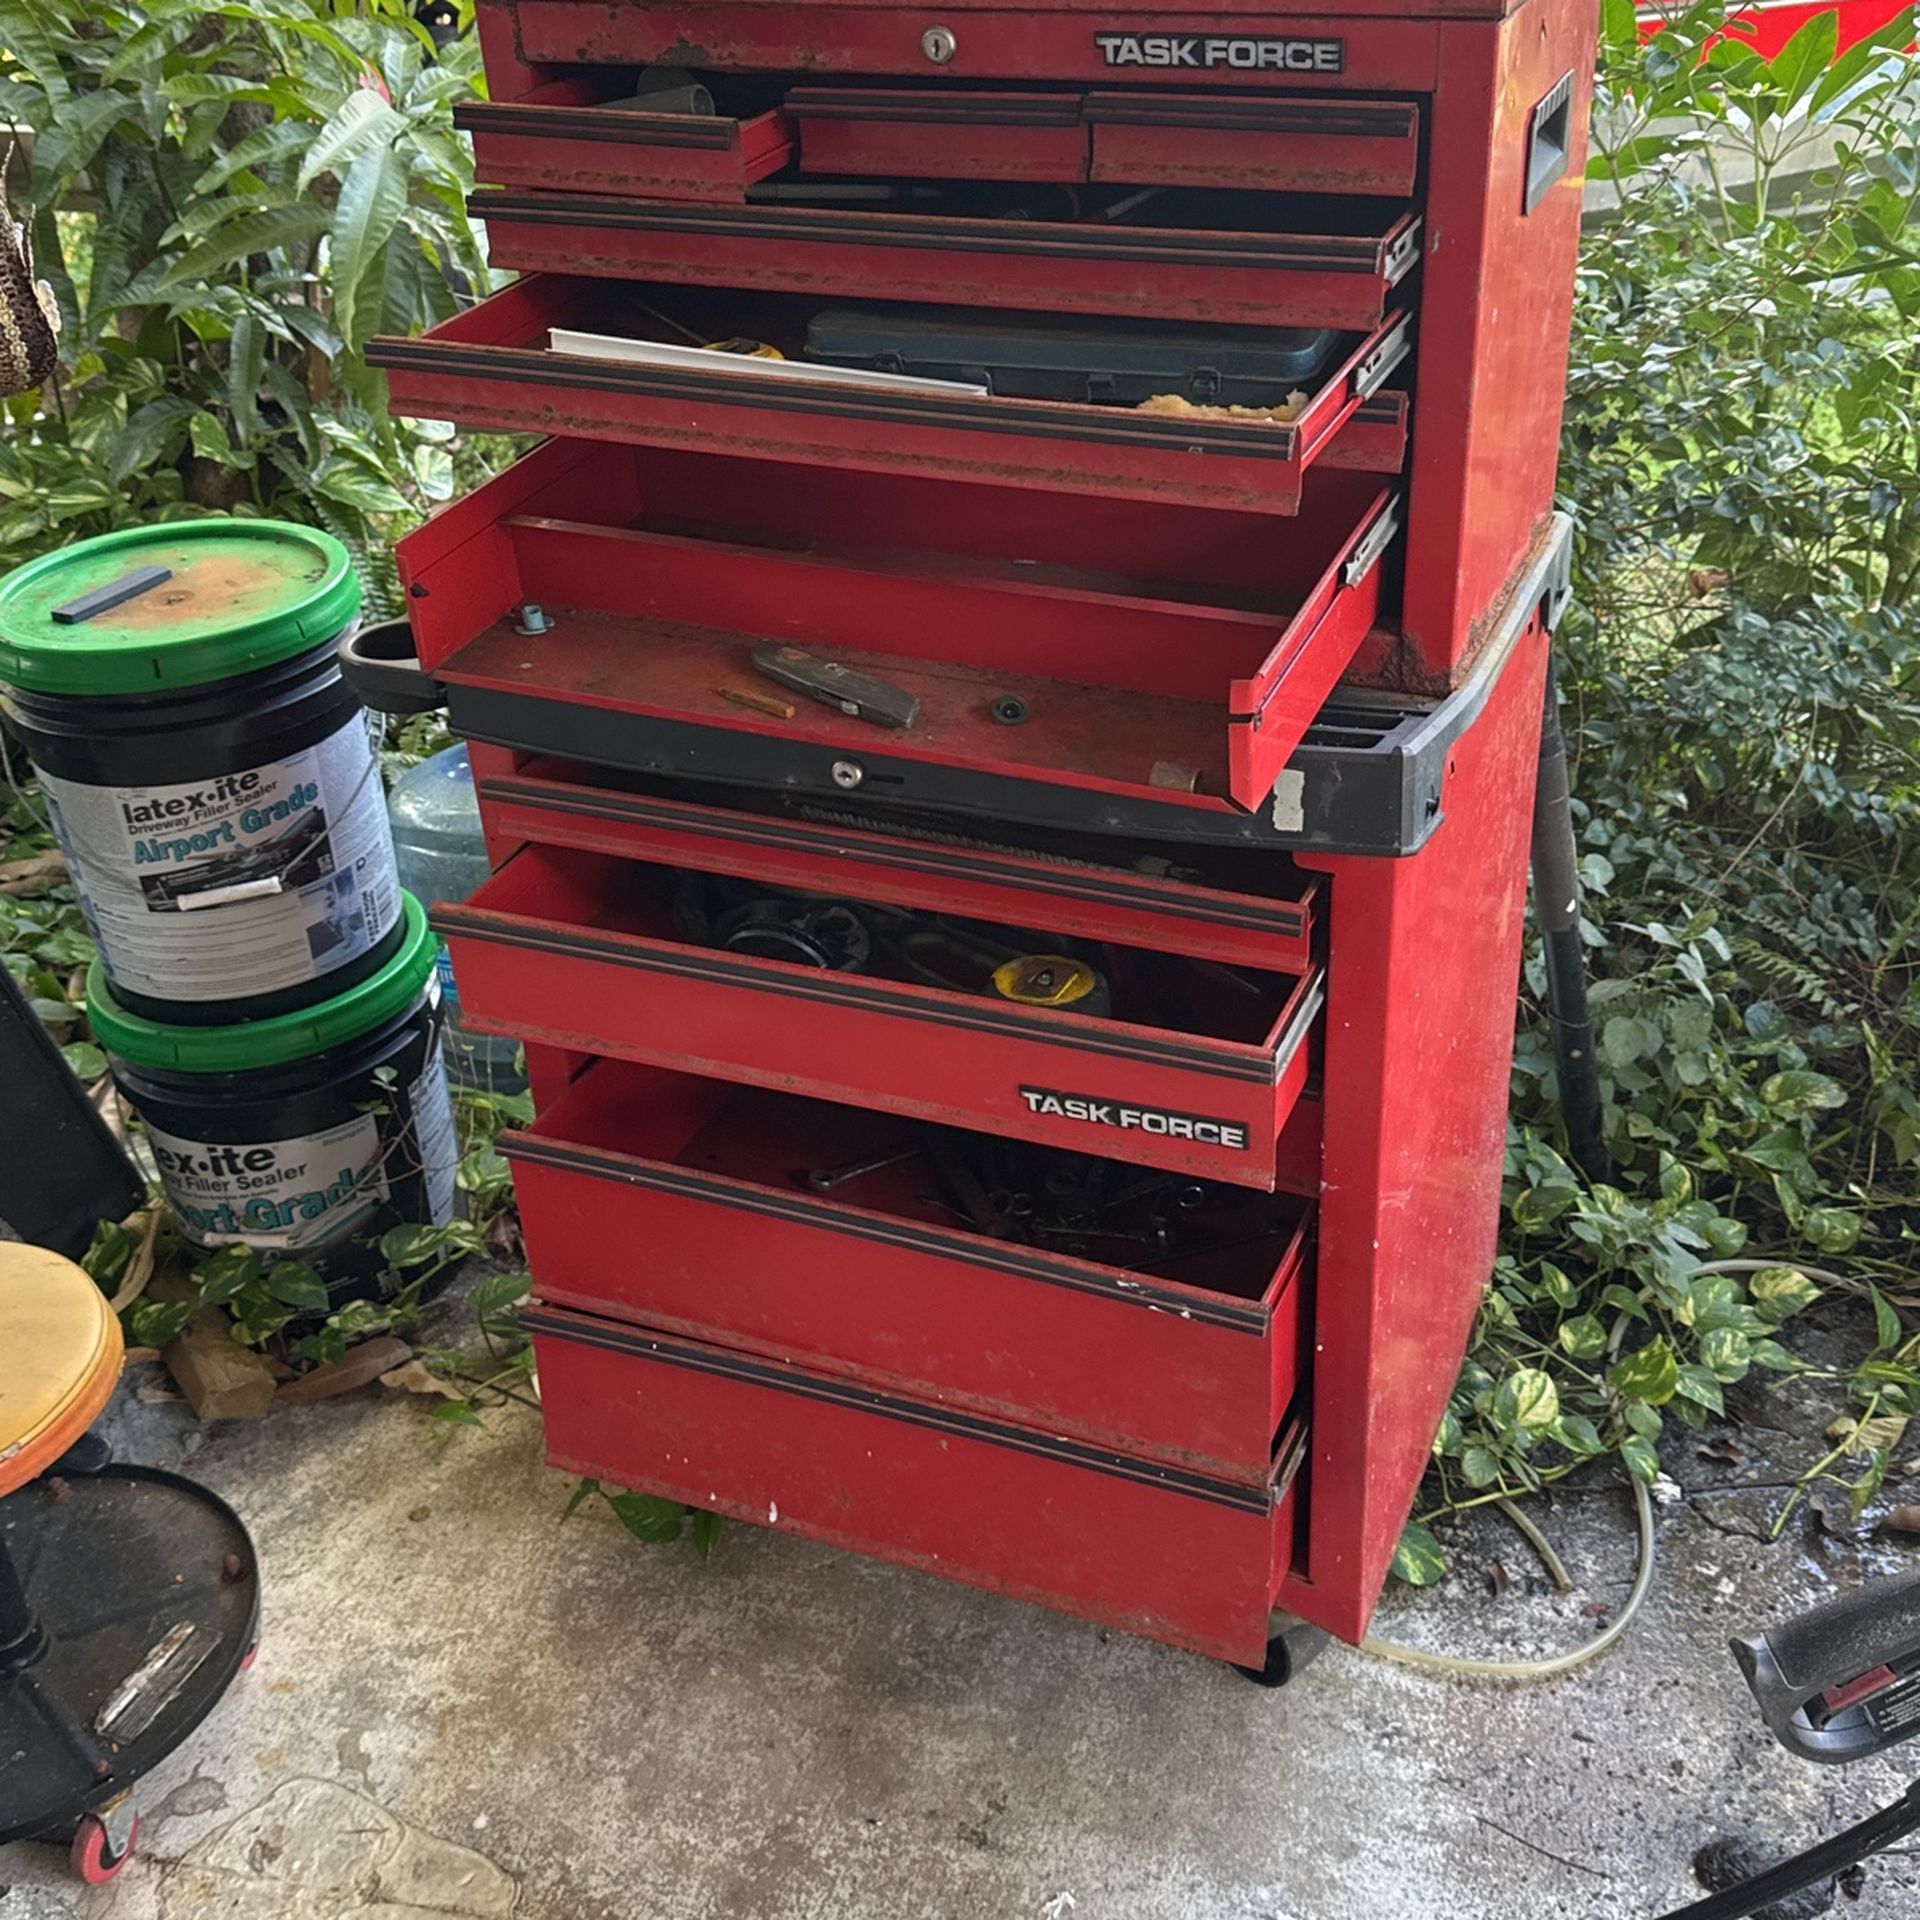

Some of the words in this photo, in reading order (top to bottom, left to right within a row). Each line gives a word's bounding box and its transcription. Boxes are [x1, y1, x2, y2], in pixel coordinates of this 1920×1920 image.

[1096, 37, 1200, 66] TASK
[1204, 39, 1341, 71] FORCE
[128, 815, 191, 836] Driveway
[194, 803, 230, 822] Filler
[235, 780, 279, 807] Sealer
[134, 819, 236, 864] Airport
[239, 781, 319, 834] Grade
[1020, 1091, 1116, 1126] TASK
[1119, 1108, 1245, 1149] FORCE
[187, 1175, 231, 1193] Filler
[237, 1163, 308, 1191] Sealer
[245, 1164, 382, 1230] Grade
